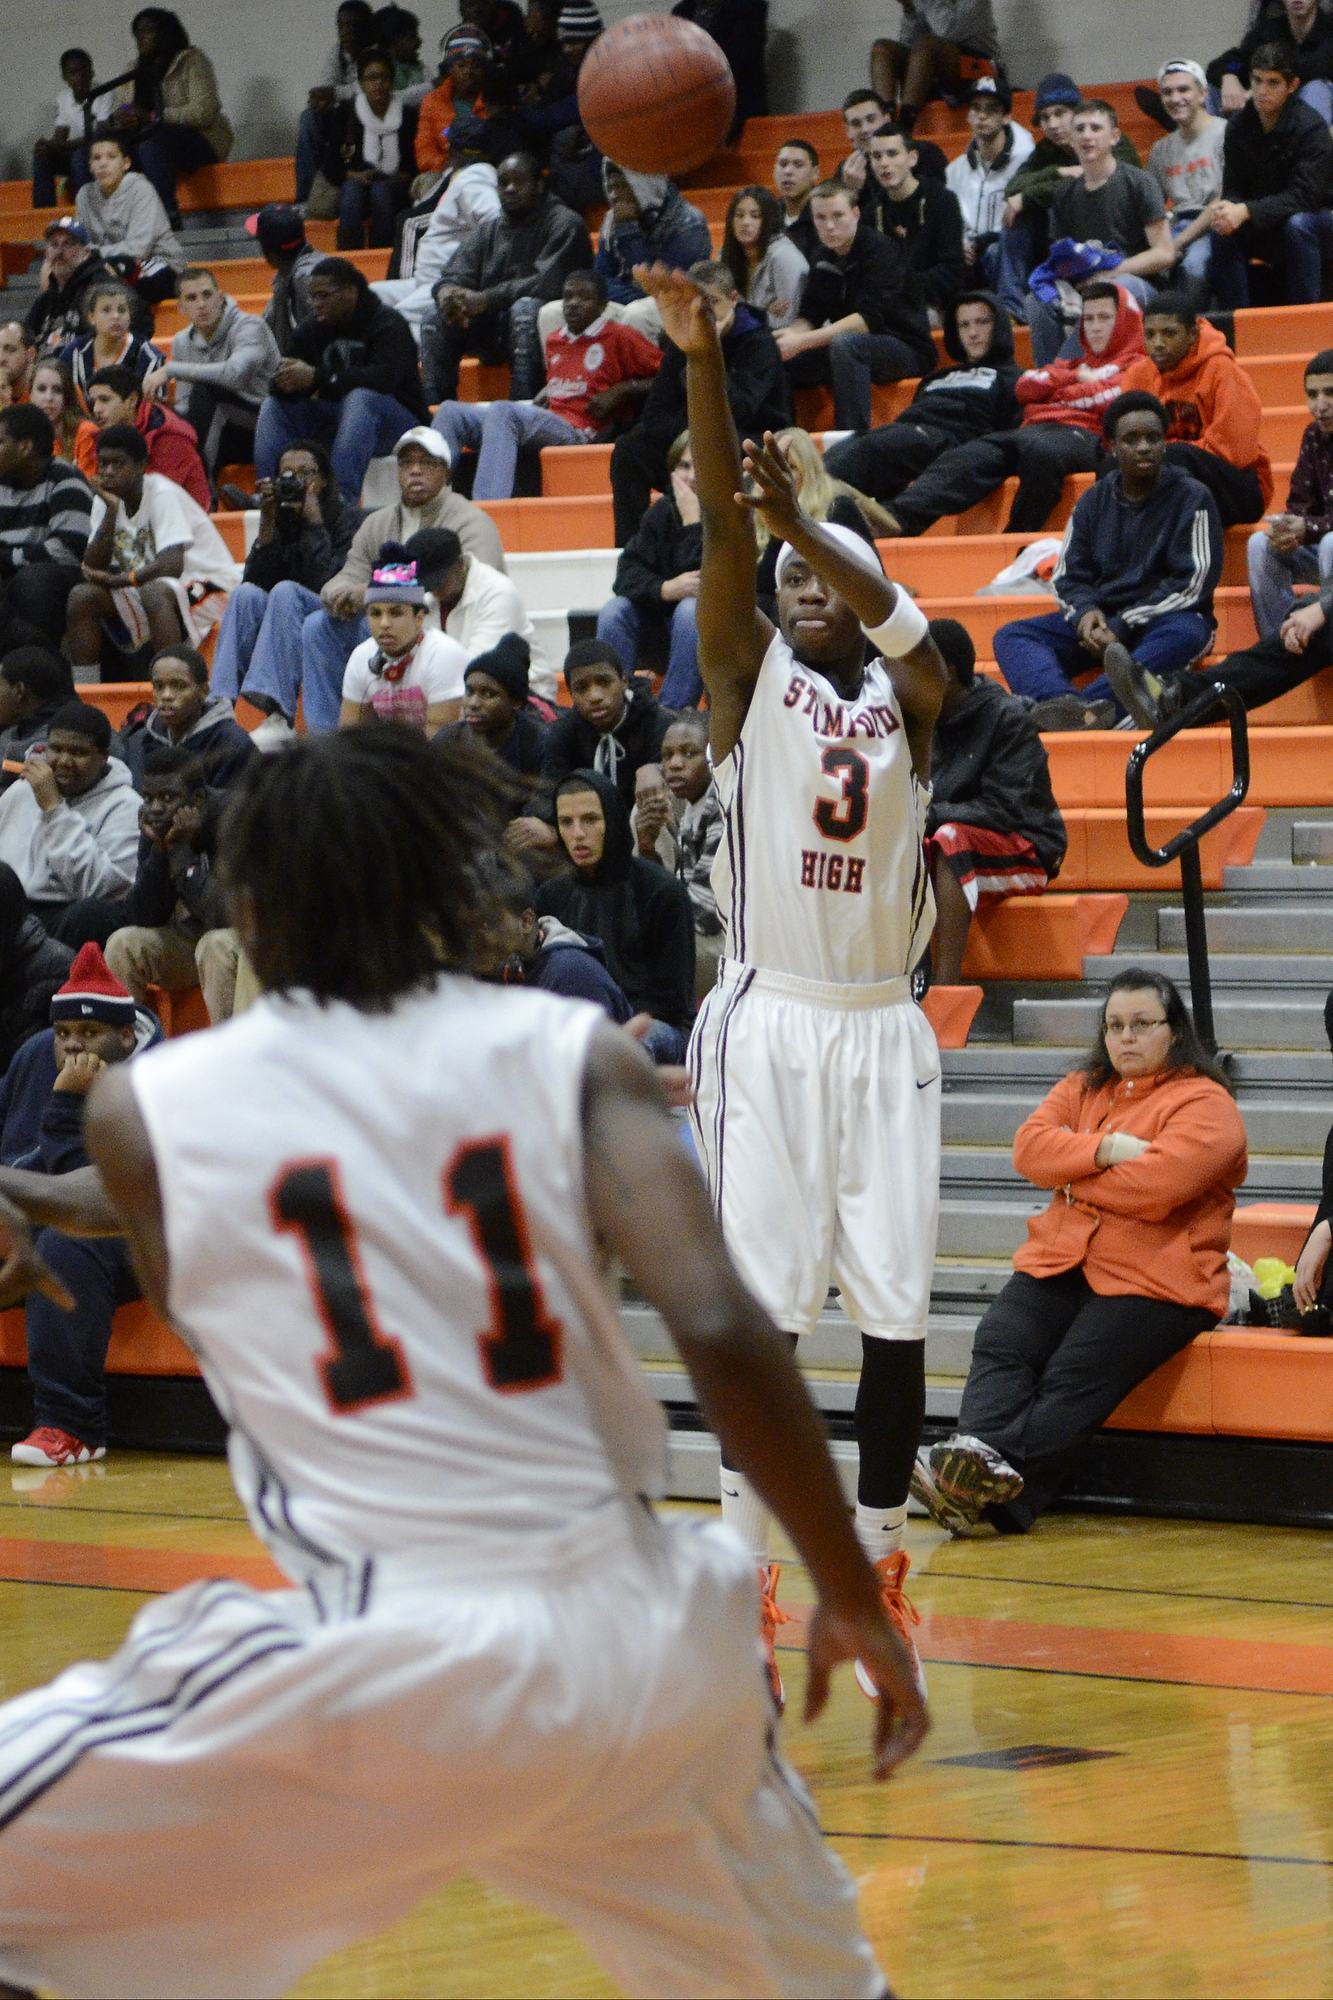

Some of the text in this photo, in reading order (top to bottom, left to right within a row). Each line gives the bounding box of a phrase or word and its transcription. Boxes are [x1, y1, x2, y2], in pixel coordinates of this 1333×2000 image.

[783, 676, 900, 738] STMOD
[812, 746, 870, 843] 3
[801, 849, 867, 894] HIGH
[265, 1130, 565, 1419] 11
